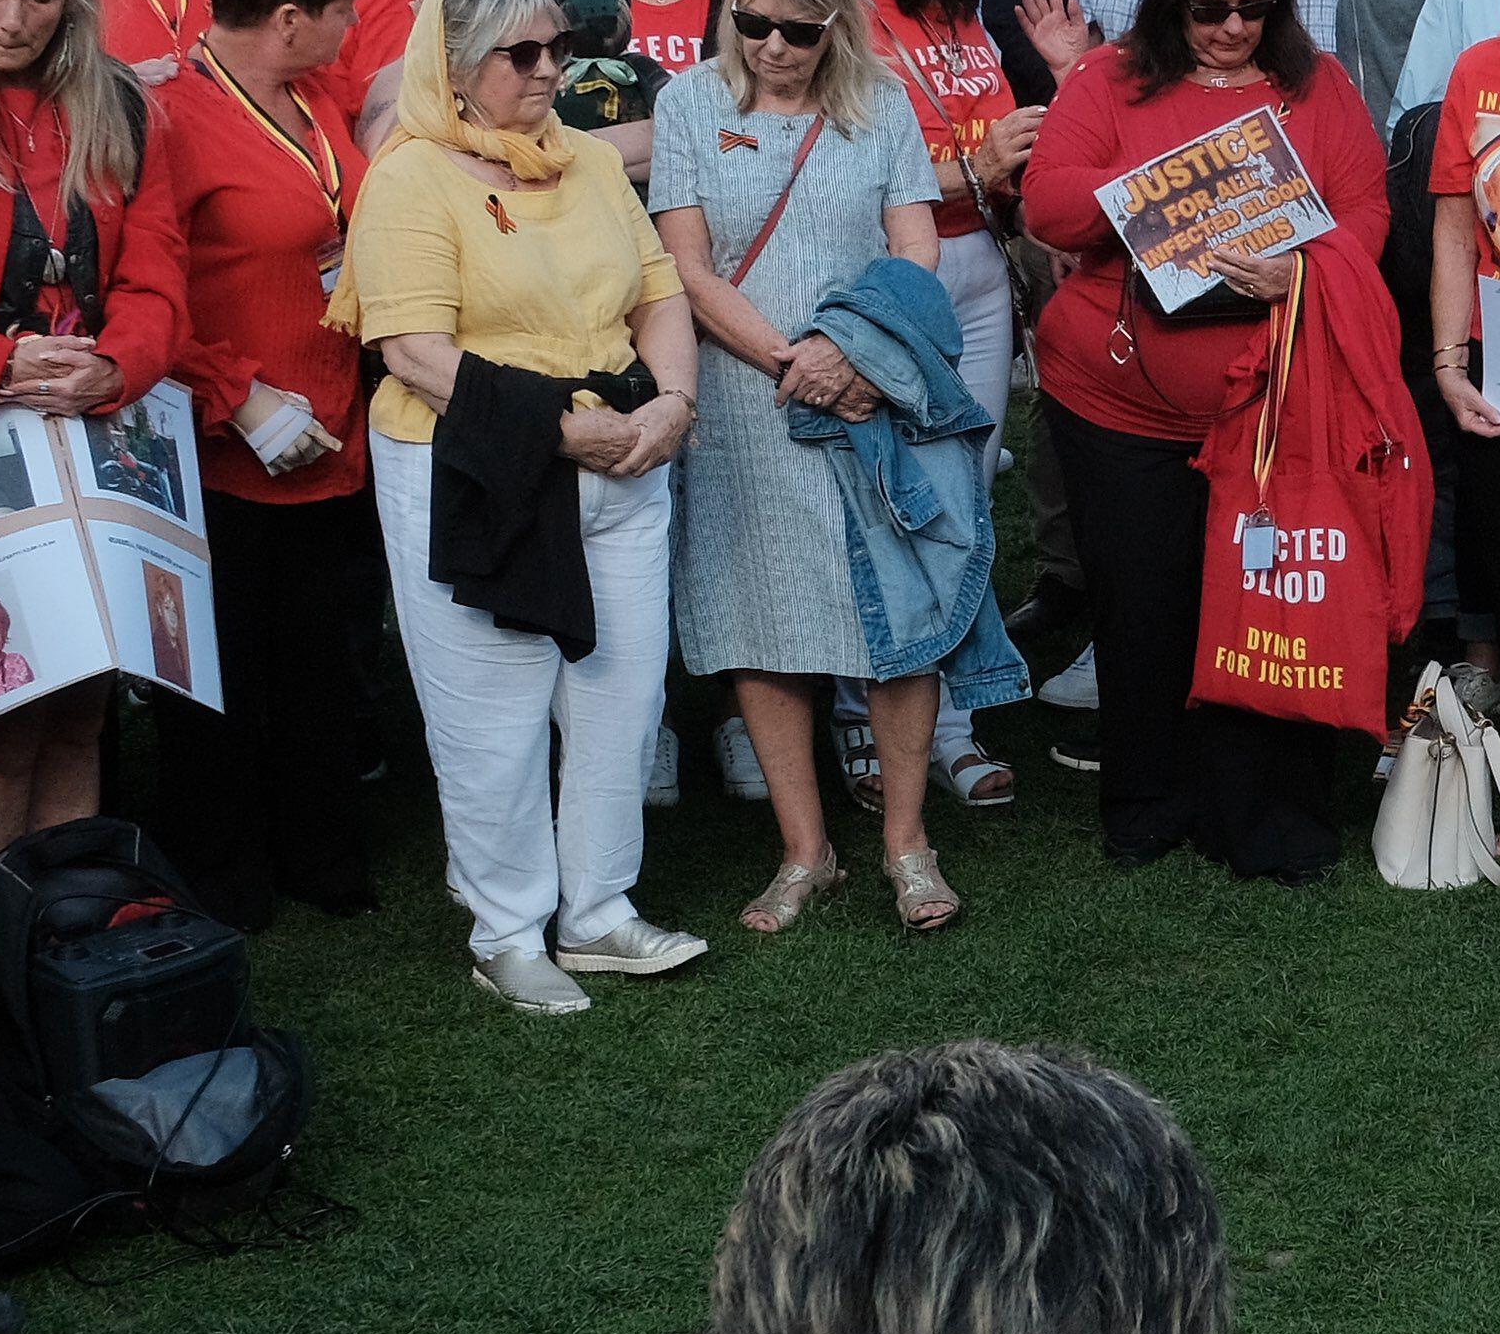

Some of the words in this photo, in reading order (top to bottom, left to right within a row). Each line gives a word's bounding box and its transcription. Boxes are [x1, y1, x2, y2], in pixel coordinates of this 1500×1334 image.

[1124, 116, 1273, 216] JUSTICE
[1139, 208, 1242, 273] INFECTED
[1239, 176, 1310, 219] BLOOD
[1161, 187, 1216, 228] FOR
[1215, 167, 1263, 204] ALL
[1232, 511, 1347, 563] ICTED
[1214, 645, 1252, 680] FOR
[1257, 659, 1345, 691] JUSTICE
[1246, 626, 1308, 662] DYING
